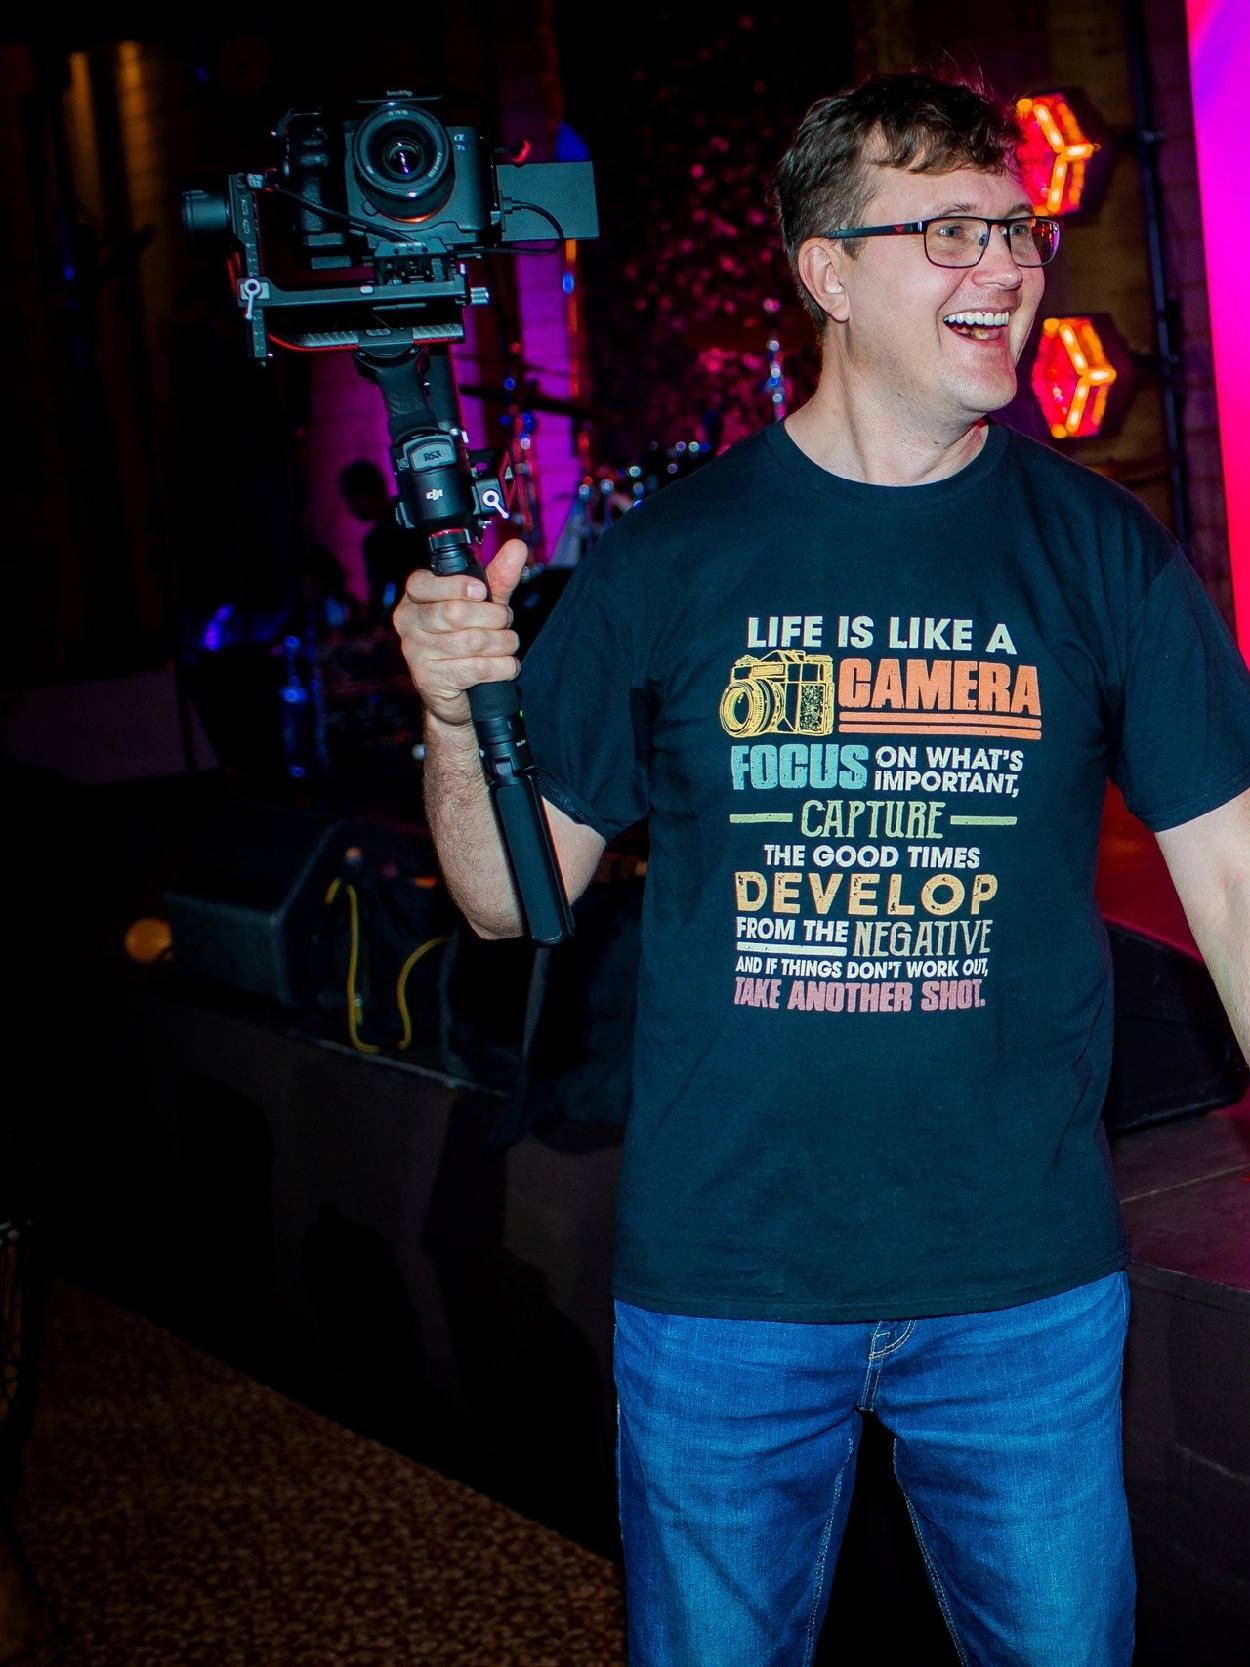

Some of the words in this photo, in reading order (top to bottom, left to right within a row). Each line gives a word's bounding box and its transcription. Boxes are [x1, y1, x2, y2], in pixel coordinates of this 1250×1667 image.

[747, 616, 823, 648] LIFE
[838, 616, 874, 648] IS
[889, 617, 973, 651] LIKE
[985, 624, 1018, 655] A
[838, 658, 1042, 716] CAMERA
[731, 744, 869, 790] FOCUS
[875, 746, 917, 769] ON
[926, 747, 1024, 772] WHAT'S
[875, 770, 1020, 798] IMPORTANT,
[801, 800, 946, 838] CAPTURE
[764, 845, 805, 866] THE
[813, 845, 899, 867] GOOD
[908, 846, 980, 868] TIMES
[735, 872, 998, 915] DEVELOP
[736, 917, 795, 942] FROM
[803, 920, 848, 942] THE
[853, 920, 993, 957] NEGATIVE
[735, 956, 762, 975] AND
[766, 958, 777, 975] IF
[781, 958, 842, 978] THINGS
[847, 959, 901, 979] DON'T
[906, 960, 959, 978] WORK
[963, 958, 988, 977] OUT,
[734, 977, 780, 1006] TAKE
[787, 979, 913, 1013] ANOTHER
[921, 980, 986, 1012] SHOT.
